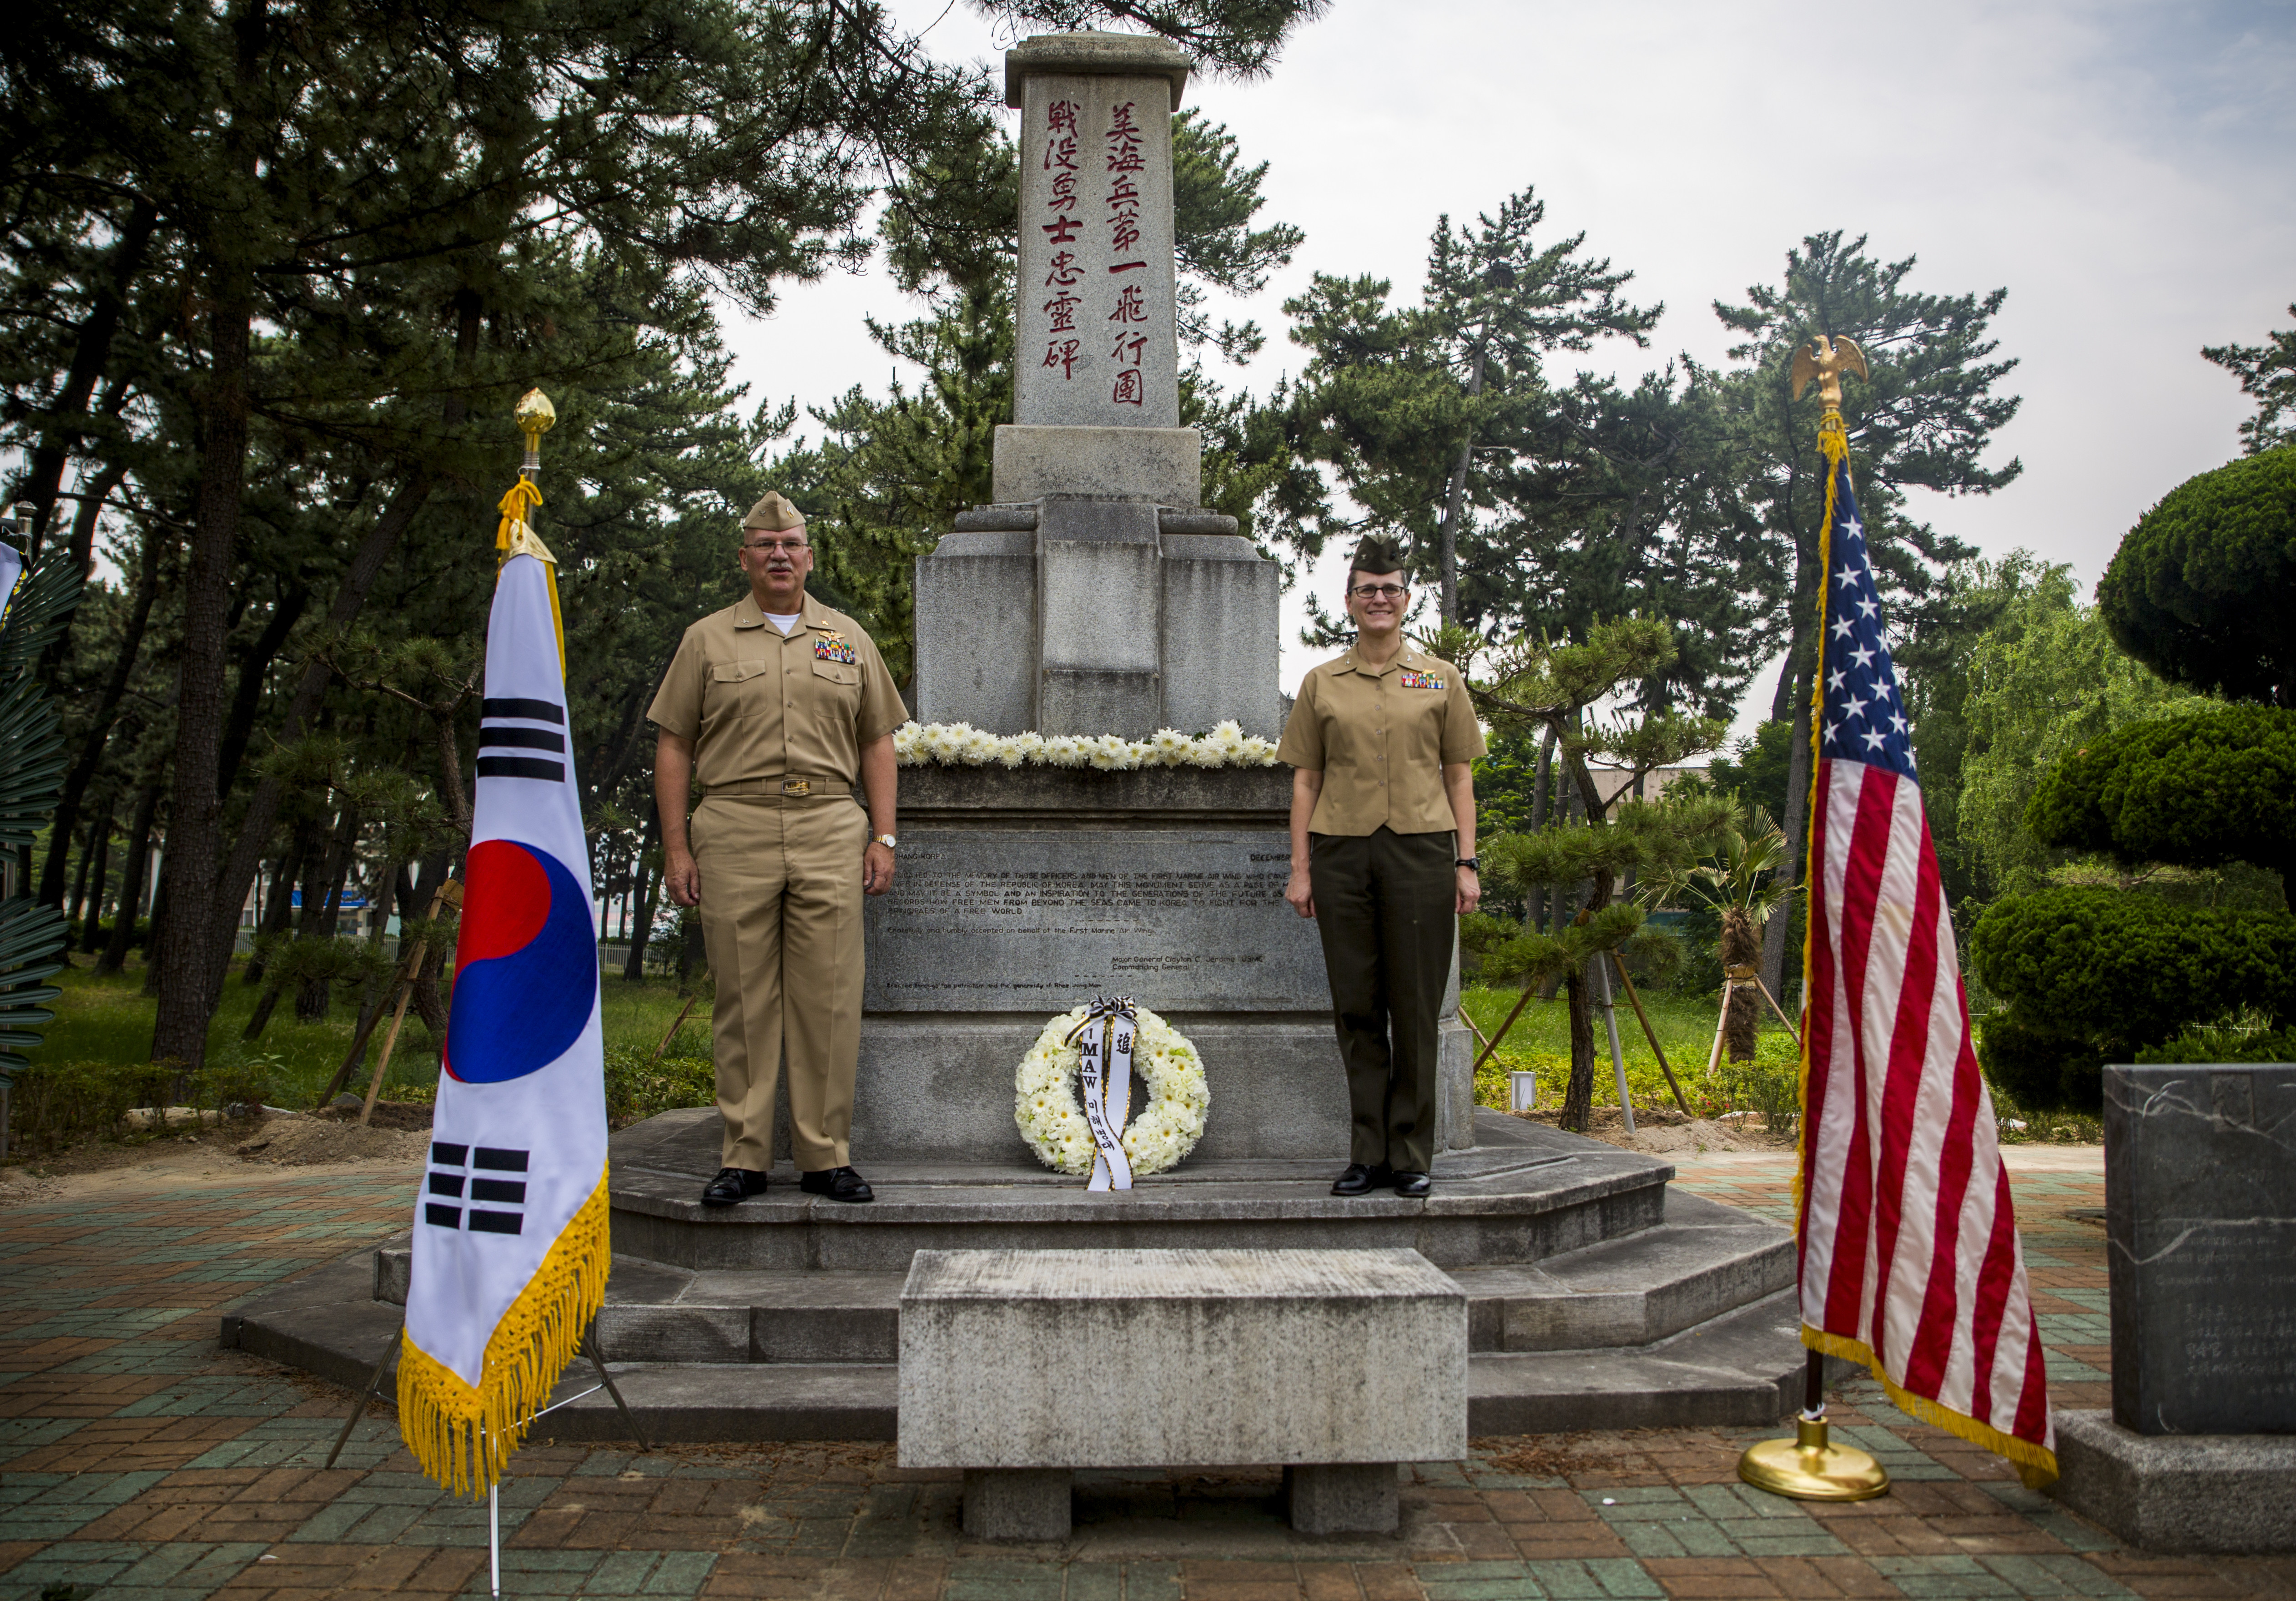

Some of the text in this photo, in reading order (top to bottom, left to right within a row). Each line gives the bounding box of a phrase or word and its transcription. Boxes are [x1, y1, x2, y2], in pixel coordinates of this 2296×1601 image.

[942, 927, 968, 935] humbly
[971, 927, 1003, 935] accepted
[1112, 964, 1158, 972] Commanding
[1116, 1032, 1131, 1055] 追
